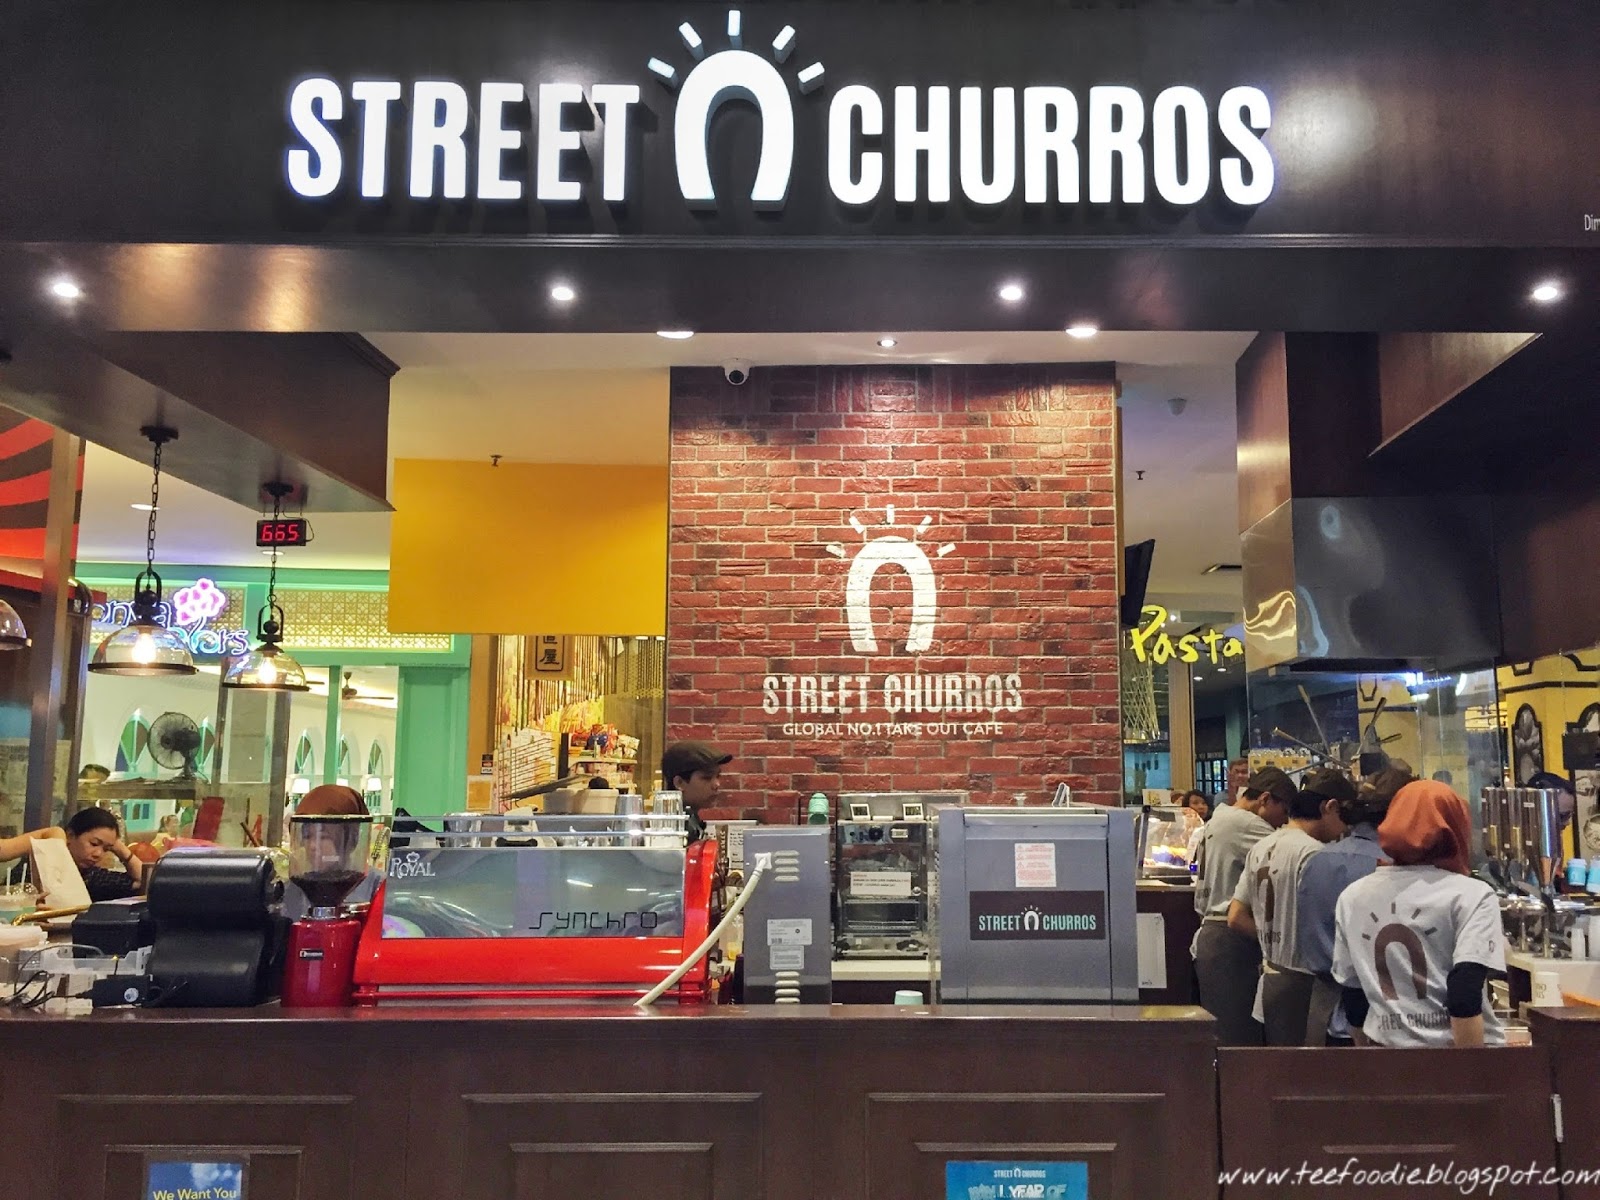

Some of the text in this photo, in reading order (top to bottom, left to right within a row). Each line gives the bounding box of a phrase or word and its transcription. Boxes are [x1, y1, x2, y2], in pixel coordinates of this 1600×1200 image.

[287, 78, 1276, 206] STREET CHURROS
[261, 524, 299, 542] 665
[1130, 604, 1244, 665] Pasta
[762, 674, 1024, 715] STREET CHURROS
[782, 722, 843, 736] GLOBAL
[883, 722, 923, 736] TAKE
[926, 722, 959, 735] OUT
[389, 857, 436, 879] ROYAL
[978, 914, 1097, 932] STREET CHURROS
[152, 1187, 237, 1200] We Want You
[1008, 1184, 1045, 1199] YEAR
